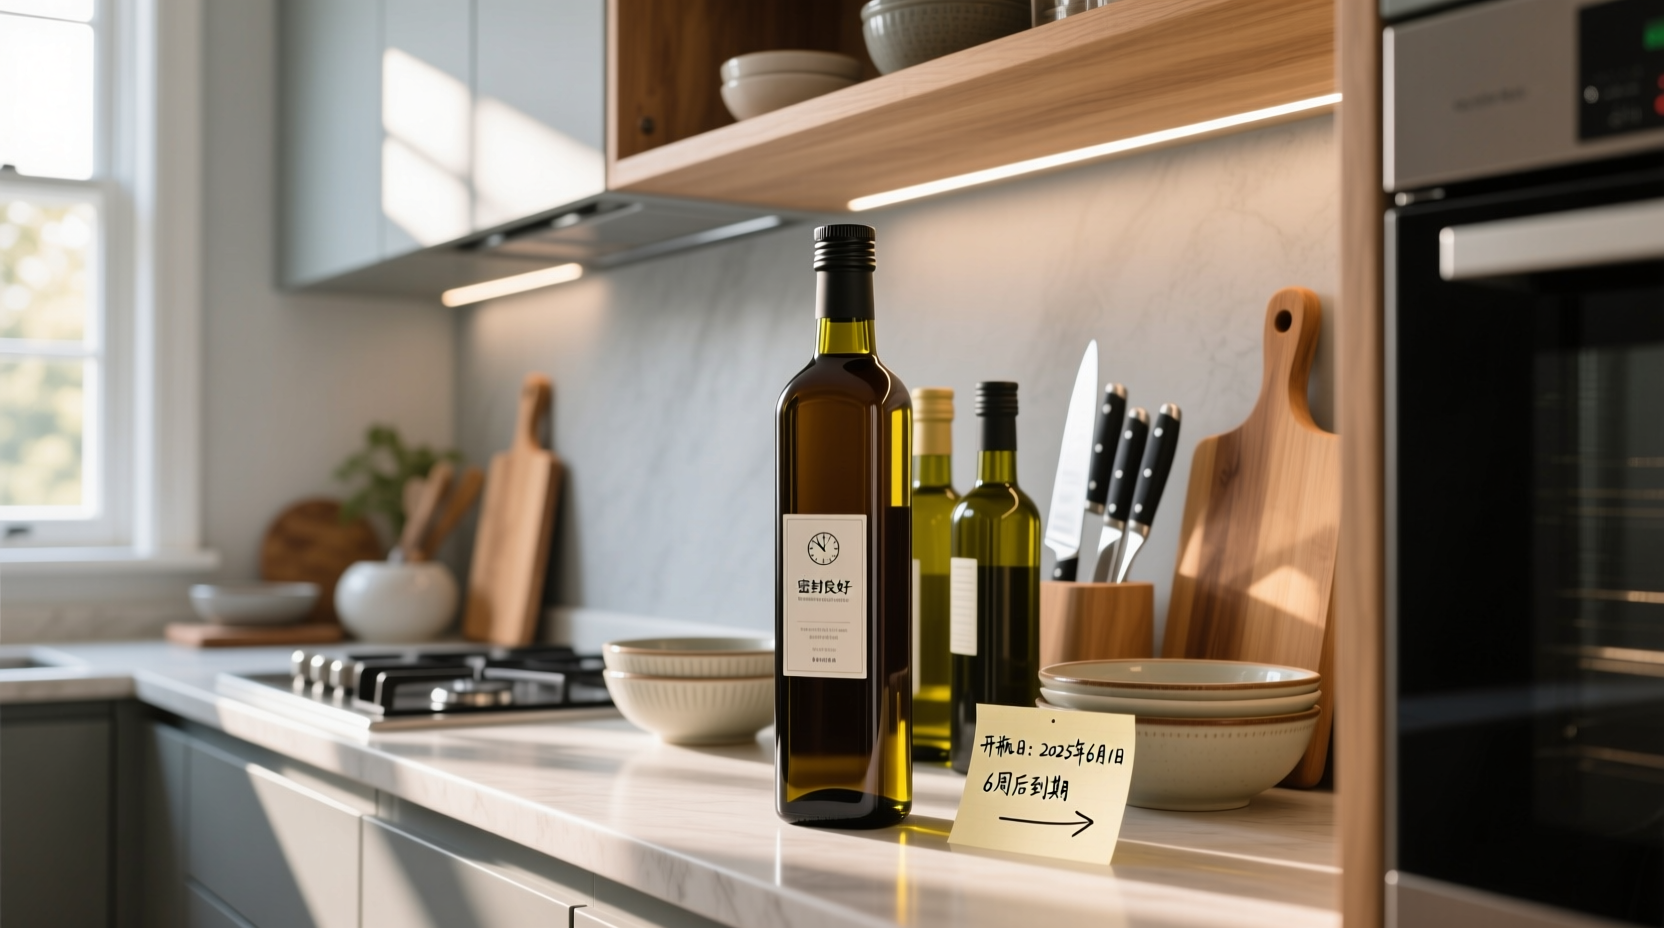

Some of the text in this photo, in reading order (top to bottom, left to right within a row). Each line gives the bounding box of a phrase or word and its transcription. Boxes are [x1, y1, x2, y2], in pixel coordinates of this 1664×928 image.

[797, 578, 852, 595] 密封良好
[983, 771, 1069, 801] 6周后到期
